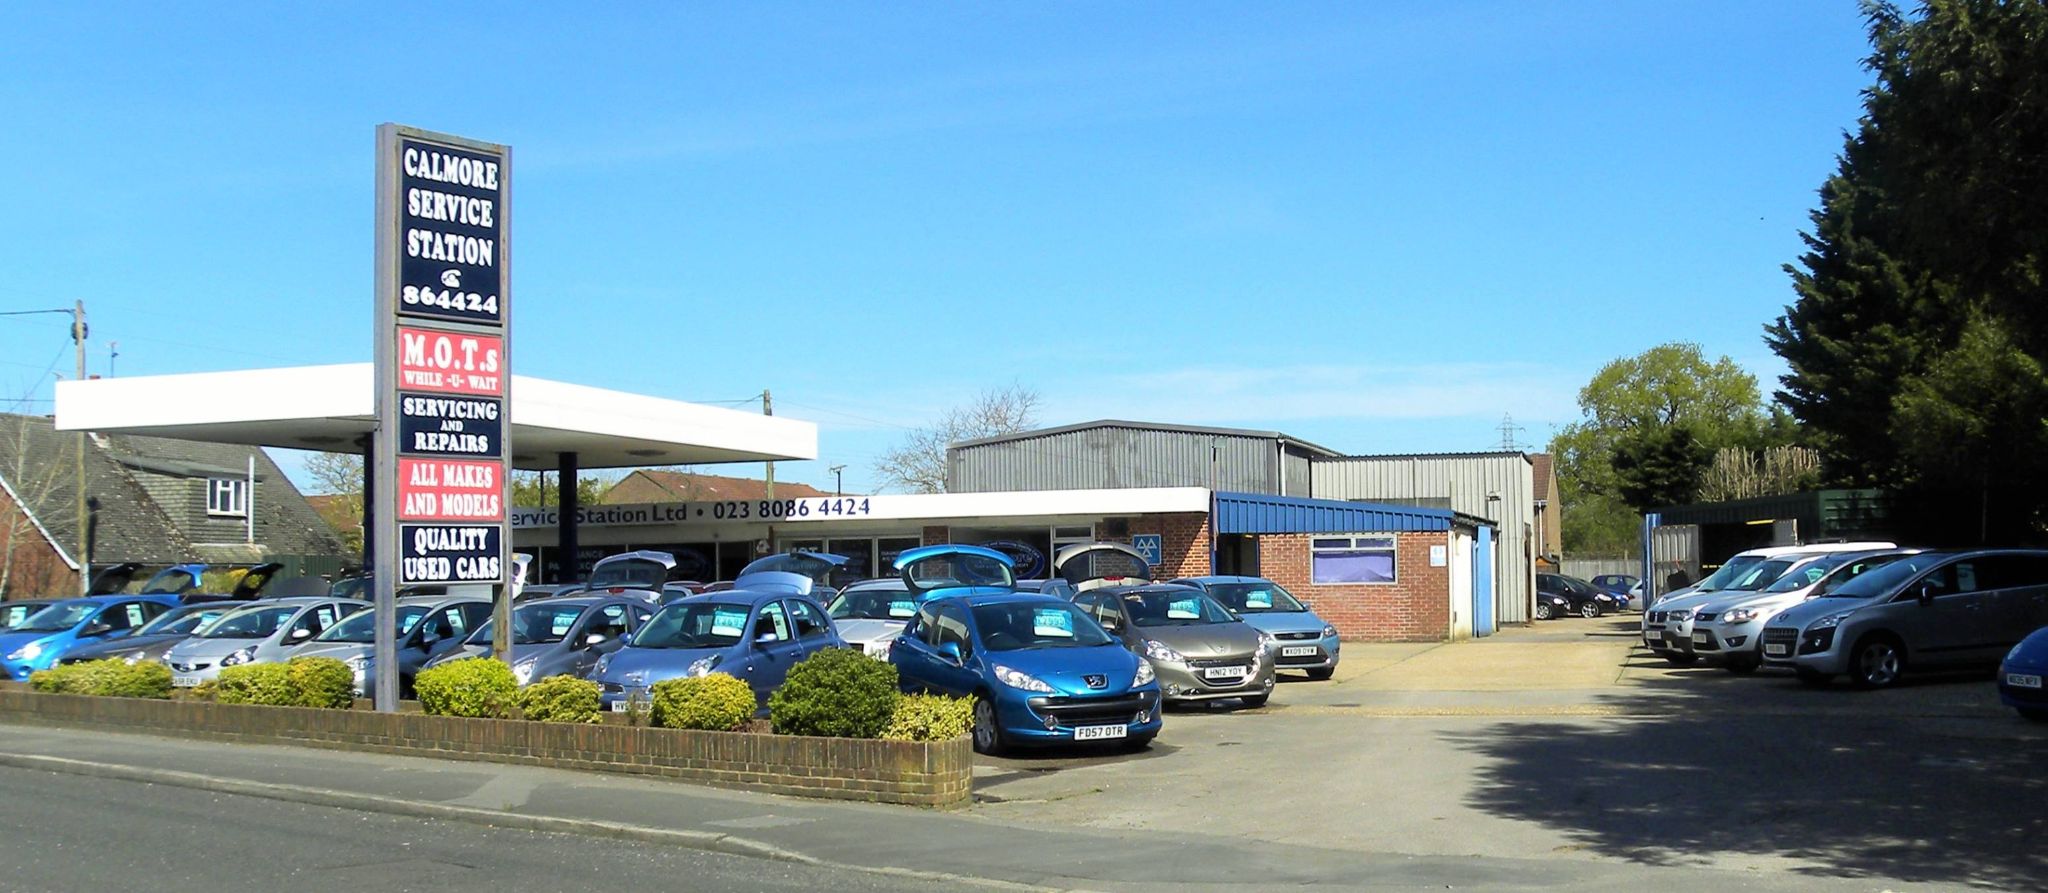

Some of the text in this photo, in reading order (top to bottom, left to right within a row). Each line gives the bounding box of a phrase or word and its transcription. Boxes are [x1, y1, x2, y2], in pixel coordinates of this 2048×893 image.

[404, 148, 498, 191] CALMORE
[408, 188, 493, 228] SERVICE
[407, 228, 493, 267] STATION
[403, 285, 498, 315] 864424
[403, 333, 498, 372] M.O.T.s
[404, 371, 443, 387] WHILE
[468, 376, 498, 391] WAIT
[403, 397, 498, 420] SERVICING
[440, 420, 463, 432] AND
[414, 432, 488, 453] REPAIRS
[410, 463, 493, 489] ALL MAKES
[404, 492, 499, 517] AND MODELS
[511, 497, 870, 526] ervic Station Ltd 023 8086 4424
[415, 528, 488, 556] QUALITY
[404, 556, 499, 580] USED CARS
[1079, 726, 1123, 738] FD57 OTR
